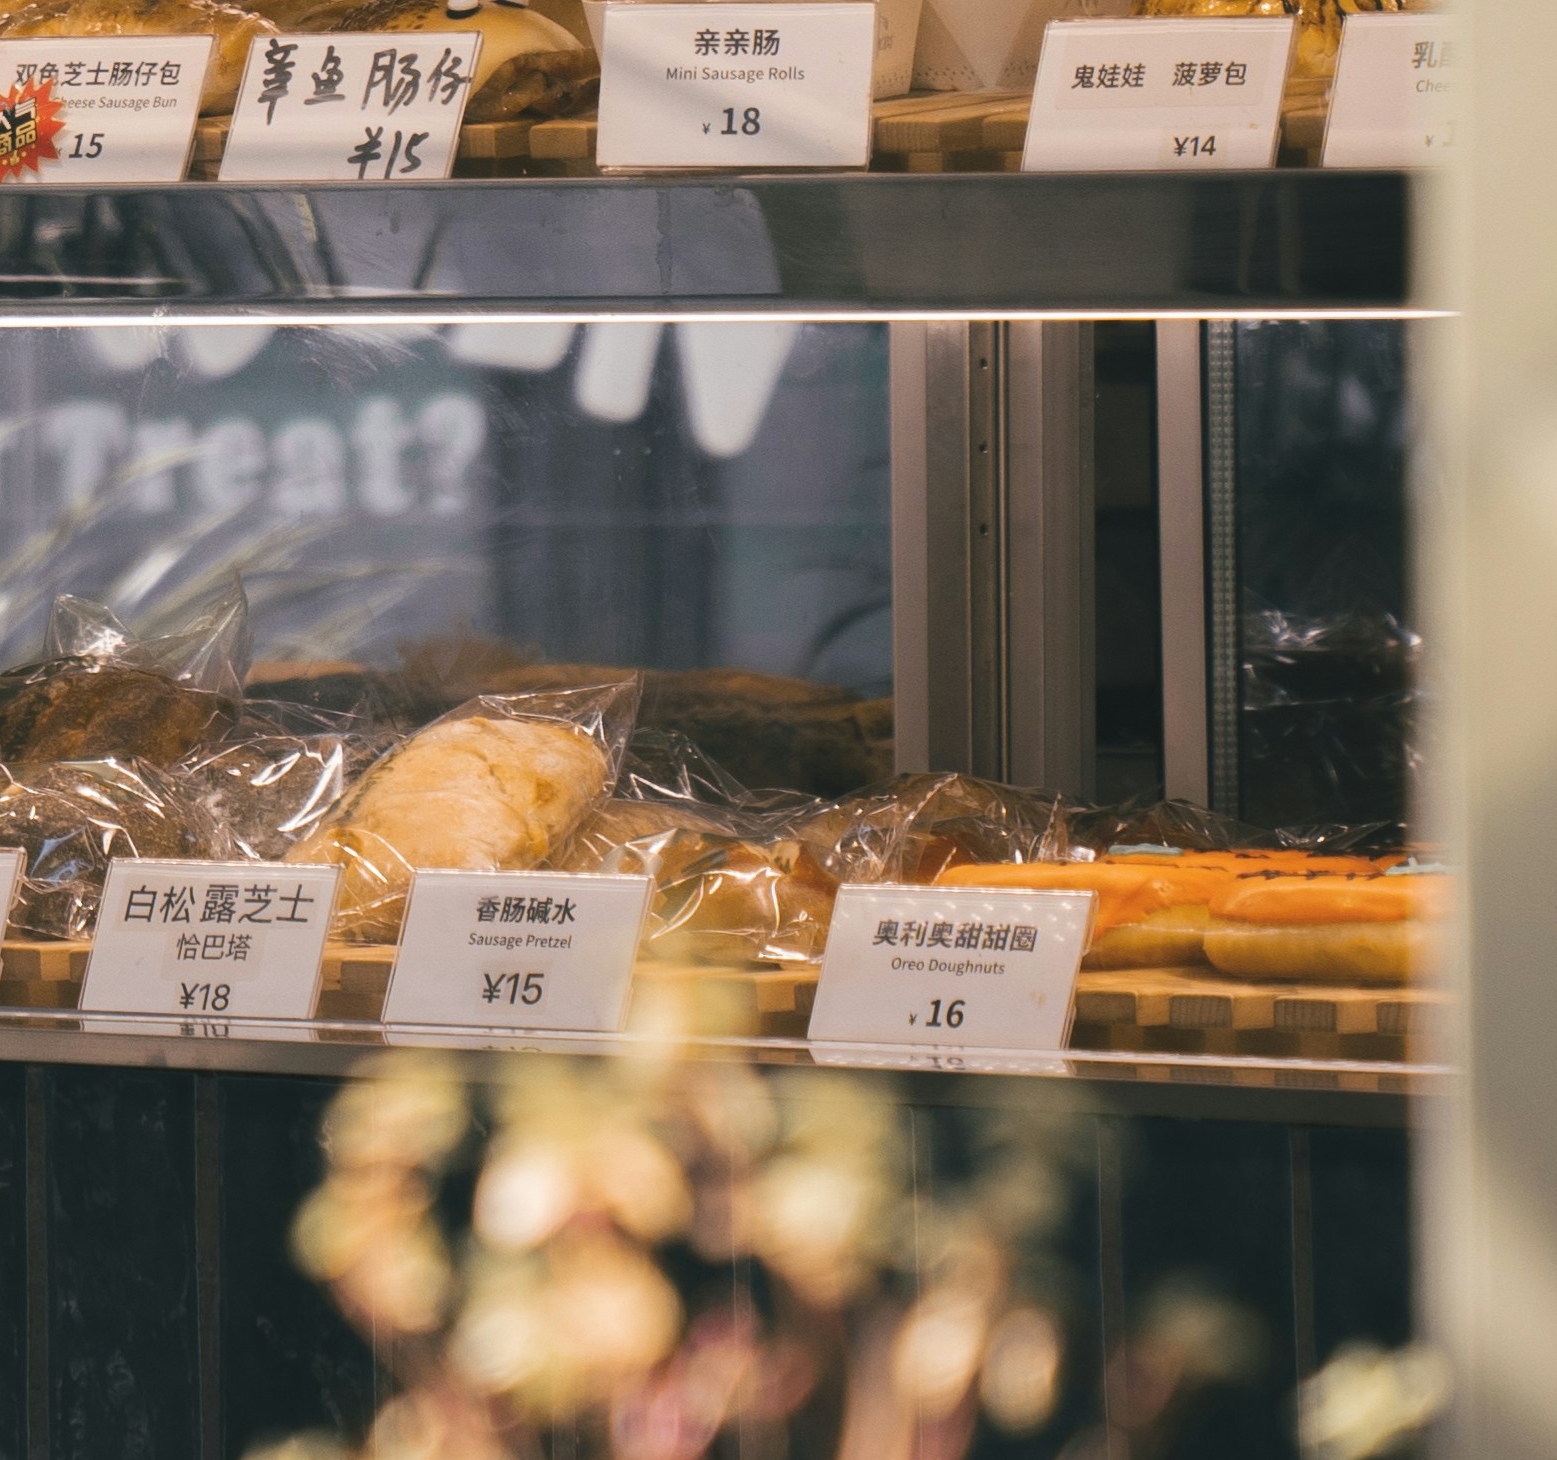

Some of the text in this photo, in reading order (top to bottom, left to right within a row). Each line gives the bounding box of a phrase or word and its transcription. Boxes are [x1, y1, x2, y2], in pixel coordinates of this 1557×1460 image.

[694, 29, 780, 56] 亲亲肠
[16, 61, 181, 86] 双色芝士肠仔包
[666, 67, 805, 83] Mini Sausage Rolls
[1071, 61, 1247, 89] 鬼娃娃 菠萝包
[98, 96, 177, 110] Sausage Bun
[348, 127, 430, 180] ¥15
[1174, 136, 1216, 156] ¥14
[124, 884, 314, 923] 白松露芝士
[476, 895, 577, 924] 香肠碱水
[176, 933, 252, 961] 恰巴塔
[469, 933, 572, 950] Sausage Pretzel
[873, 919, 1038, 952] 奥利奥甜甜圈
[891, 957, 1005, 976] Oreo Doughnuts
[180, 983, 230, 1010] ¥18
[482, 973, 545, 1005] ¥15
